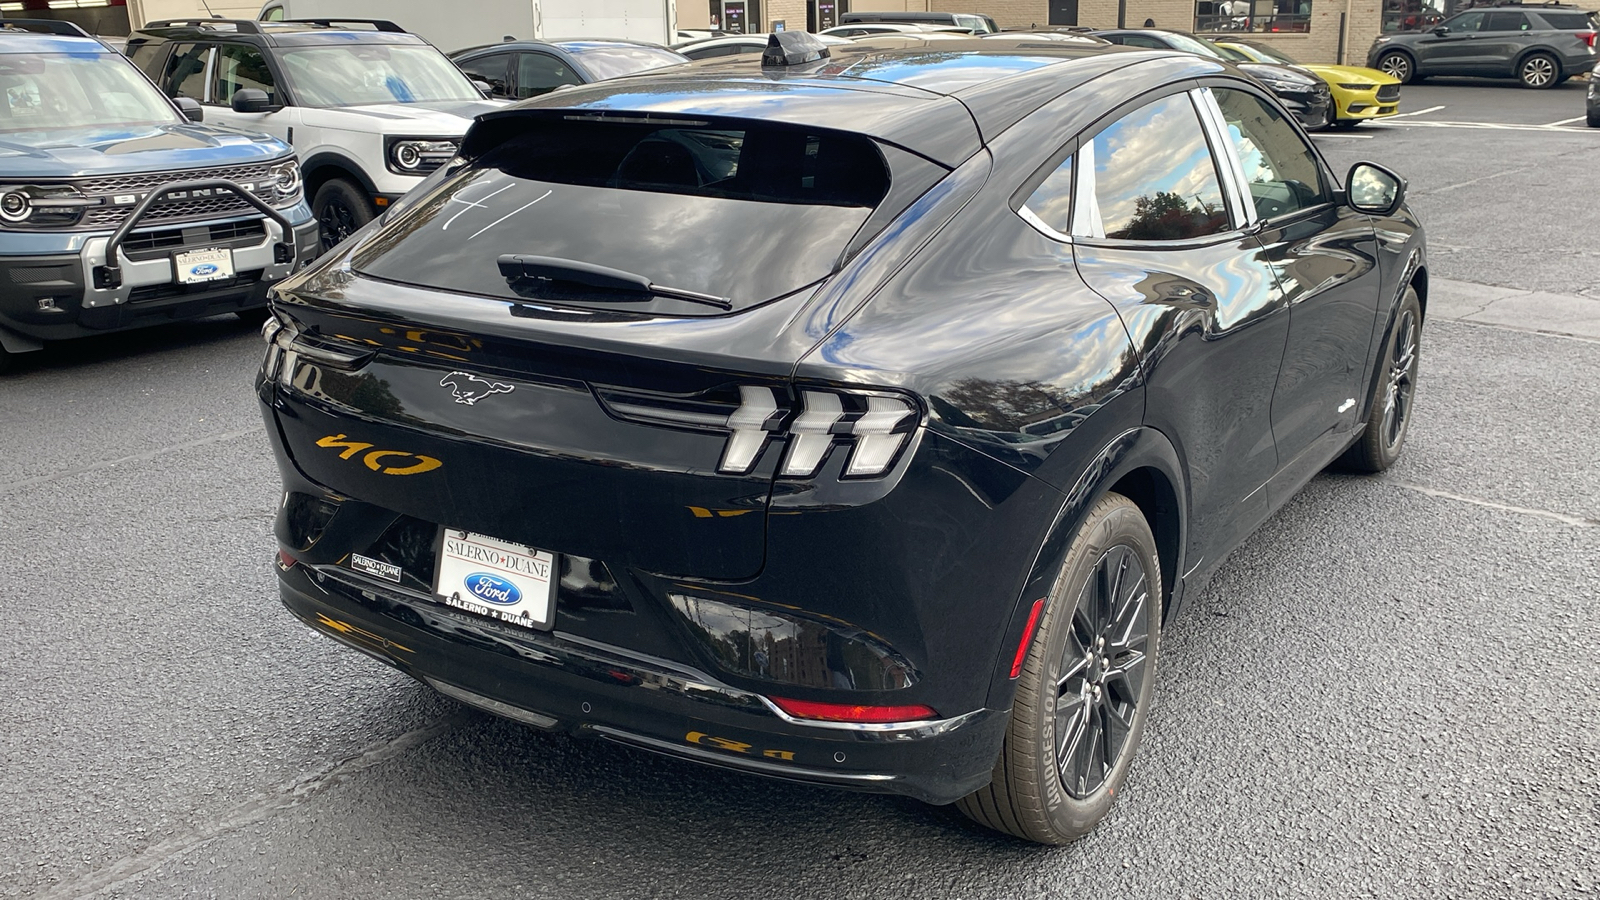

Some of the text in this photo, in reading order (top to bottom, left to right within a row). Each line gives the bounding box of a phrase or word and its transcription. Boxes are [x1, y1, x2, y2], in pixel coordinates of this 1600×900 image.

[195, 265, 213, 275] Ford
[353, 555, 376, 569] SALERNO
[380, 563, 399, 576] DUANE
[446, 540, 549, 578] SALERNO DUANE
[474, 576, 511, 602] Ford
[445, 596, 488, 616] SALERNO
[501, 611, 534, 628] DUANE
[1042, 663, 1062, 813] BRIDGESTONE
